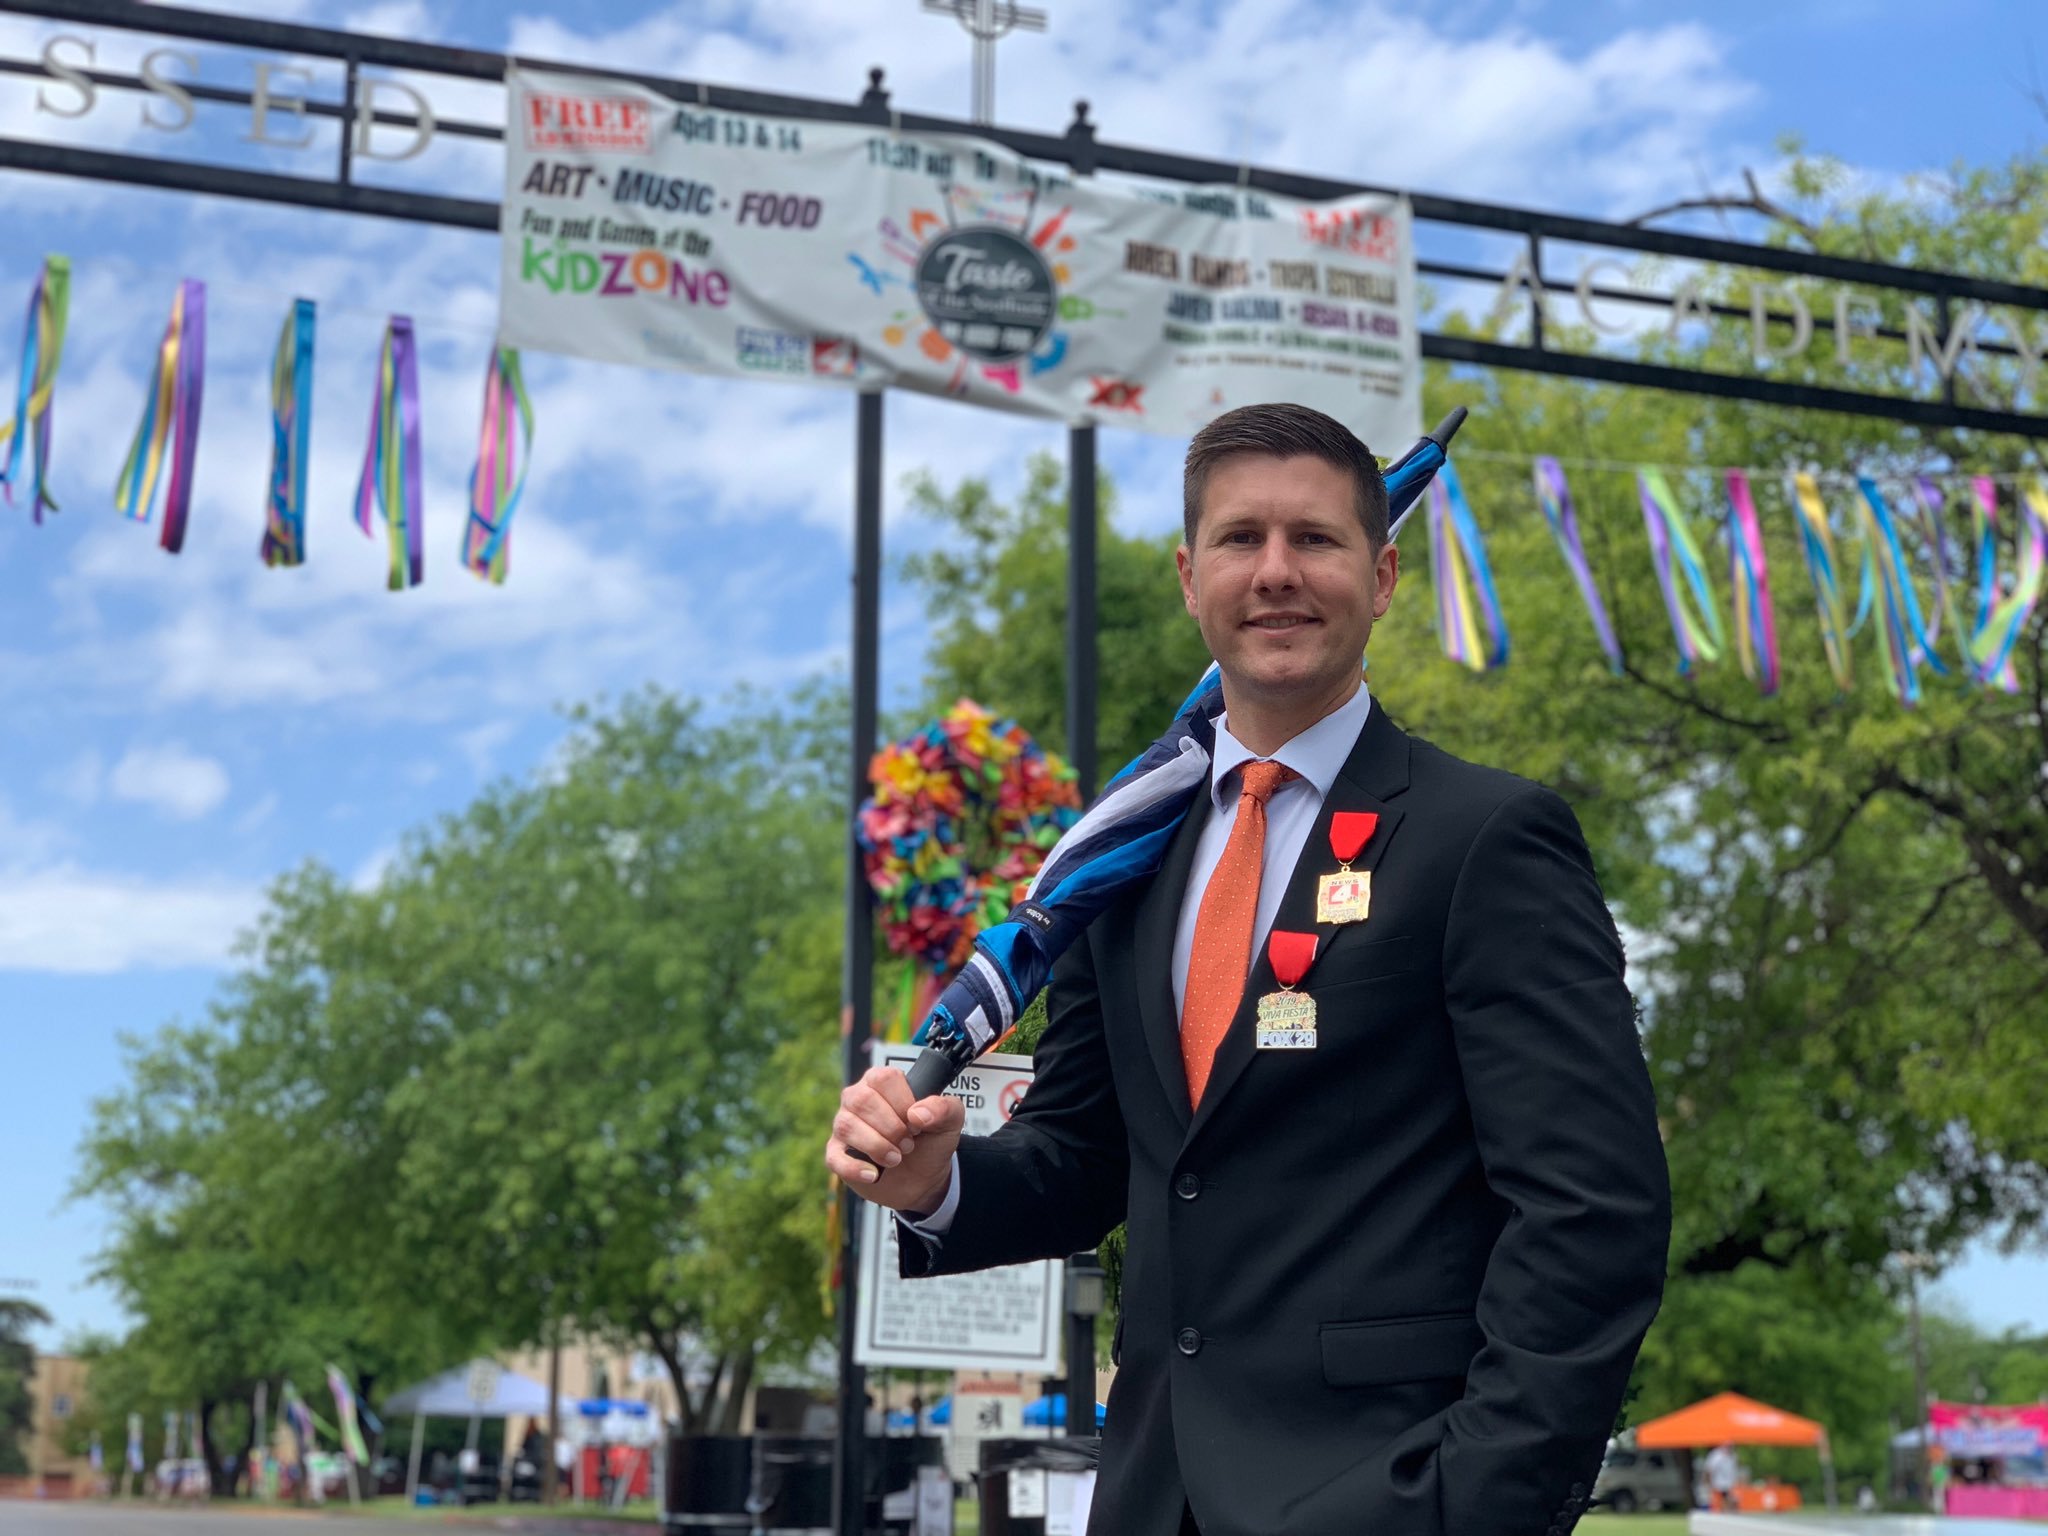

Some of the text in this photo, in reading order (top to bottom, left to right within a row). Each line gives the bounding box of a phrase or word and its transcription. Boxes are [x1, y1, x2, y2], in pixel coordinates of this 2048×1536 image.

[529, 97, 649, 131] FREE
[521, 160, 823, 231] ART MUSIC FOOD
[935, 243, 1034, 293] Taste
[1262, 1006, 1310, 1020] VIVA FIESTA
